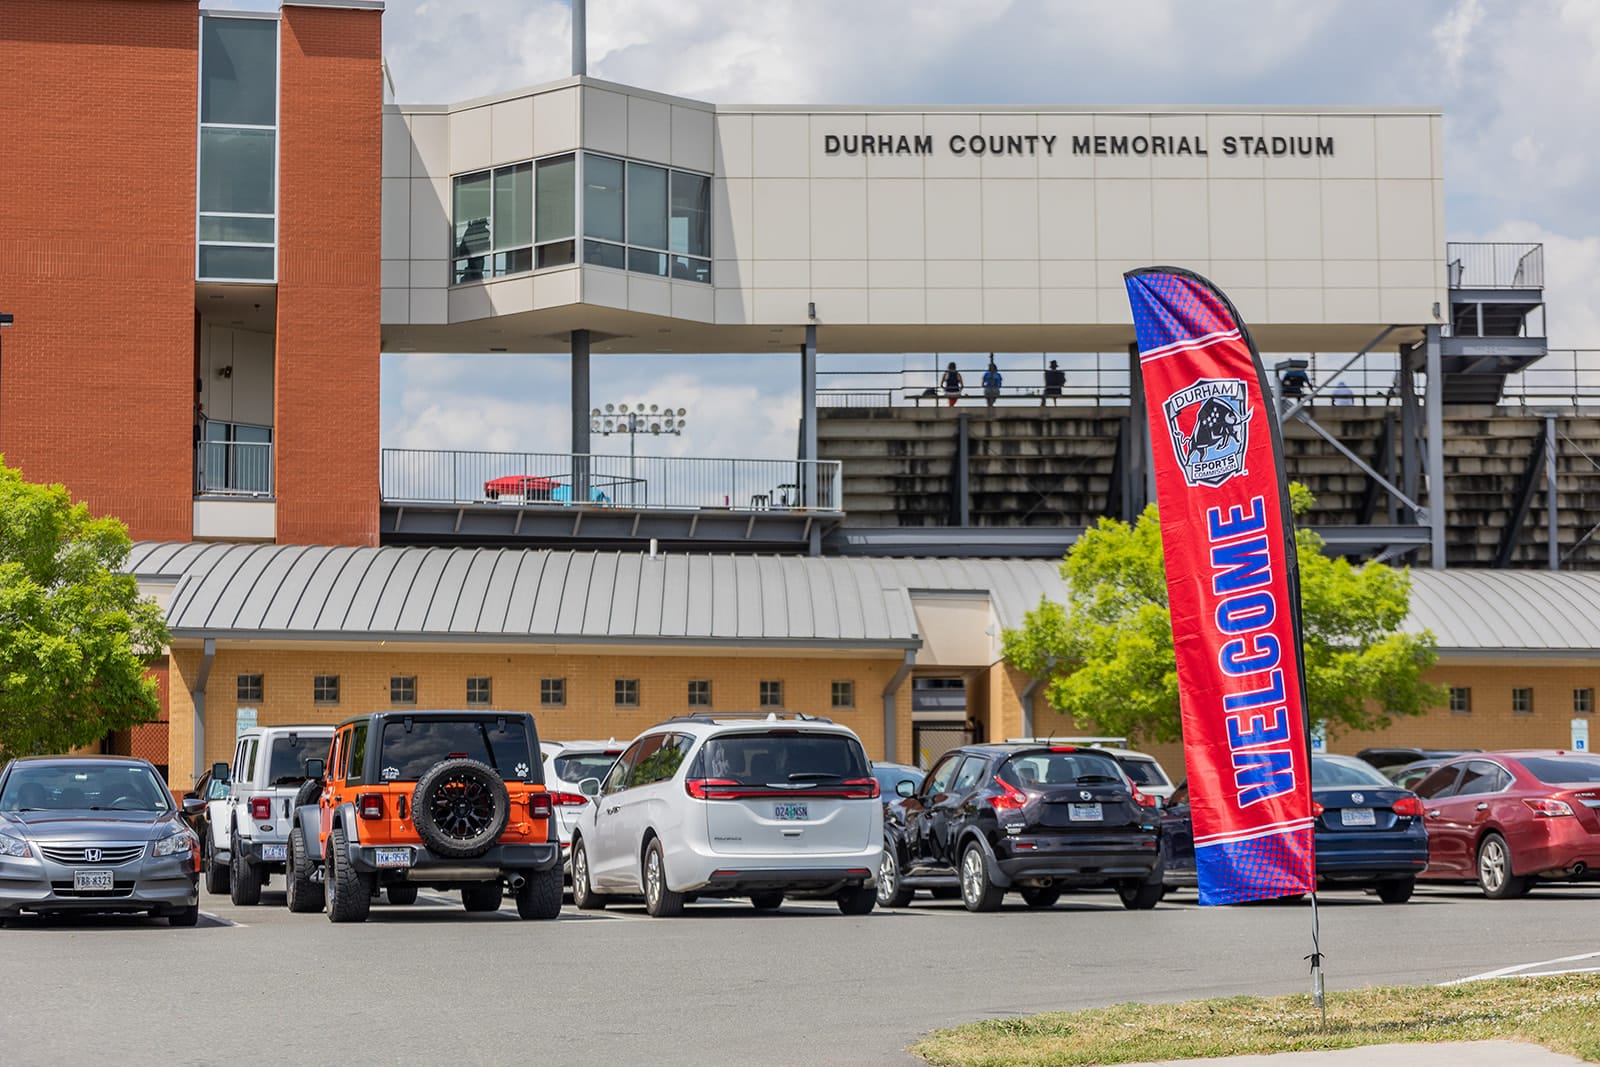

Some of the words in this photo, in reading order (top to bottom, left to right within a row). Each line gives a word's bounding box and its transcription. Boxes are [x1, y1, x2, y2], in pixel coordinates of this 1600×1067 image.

[825, 134, 933, 156] DURHAM
[949, 134, 1057, 156] COUNTY
[1072, 135, 1208, 156] MEMORIAL
[1223, 136, 1335, 157] STADIUM
[1174, 383, 1235, 409] DURHAM
[1194, 454, 1236, 473] SPORTS
[1207, 495, 1296, 808] WELCOME
